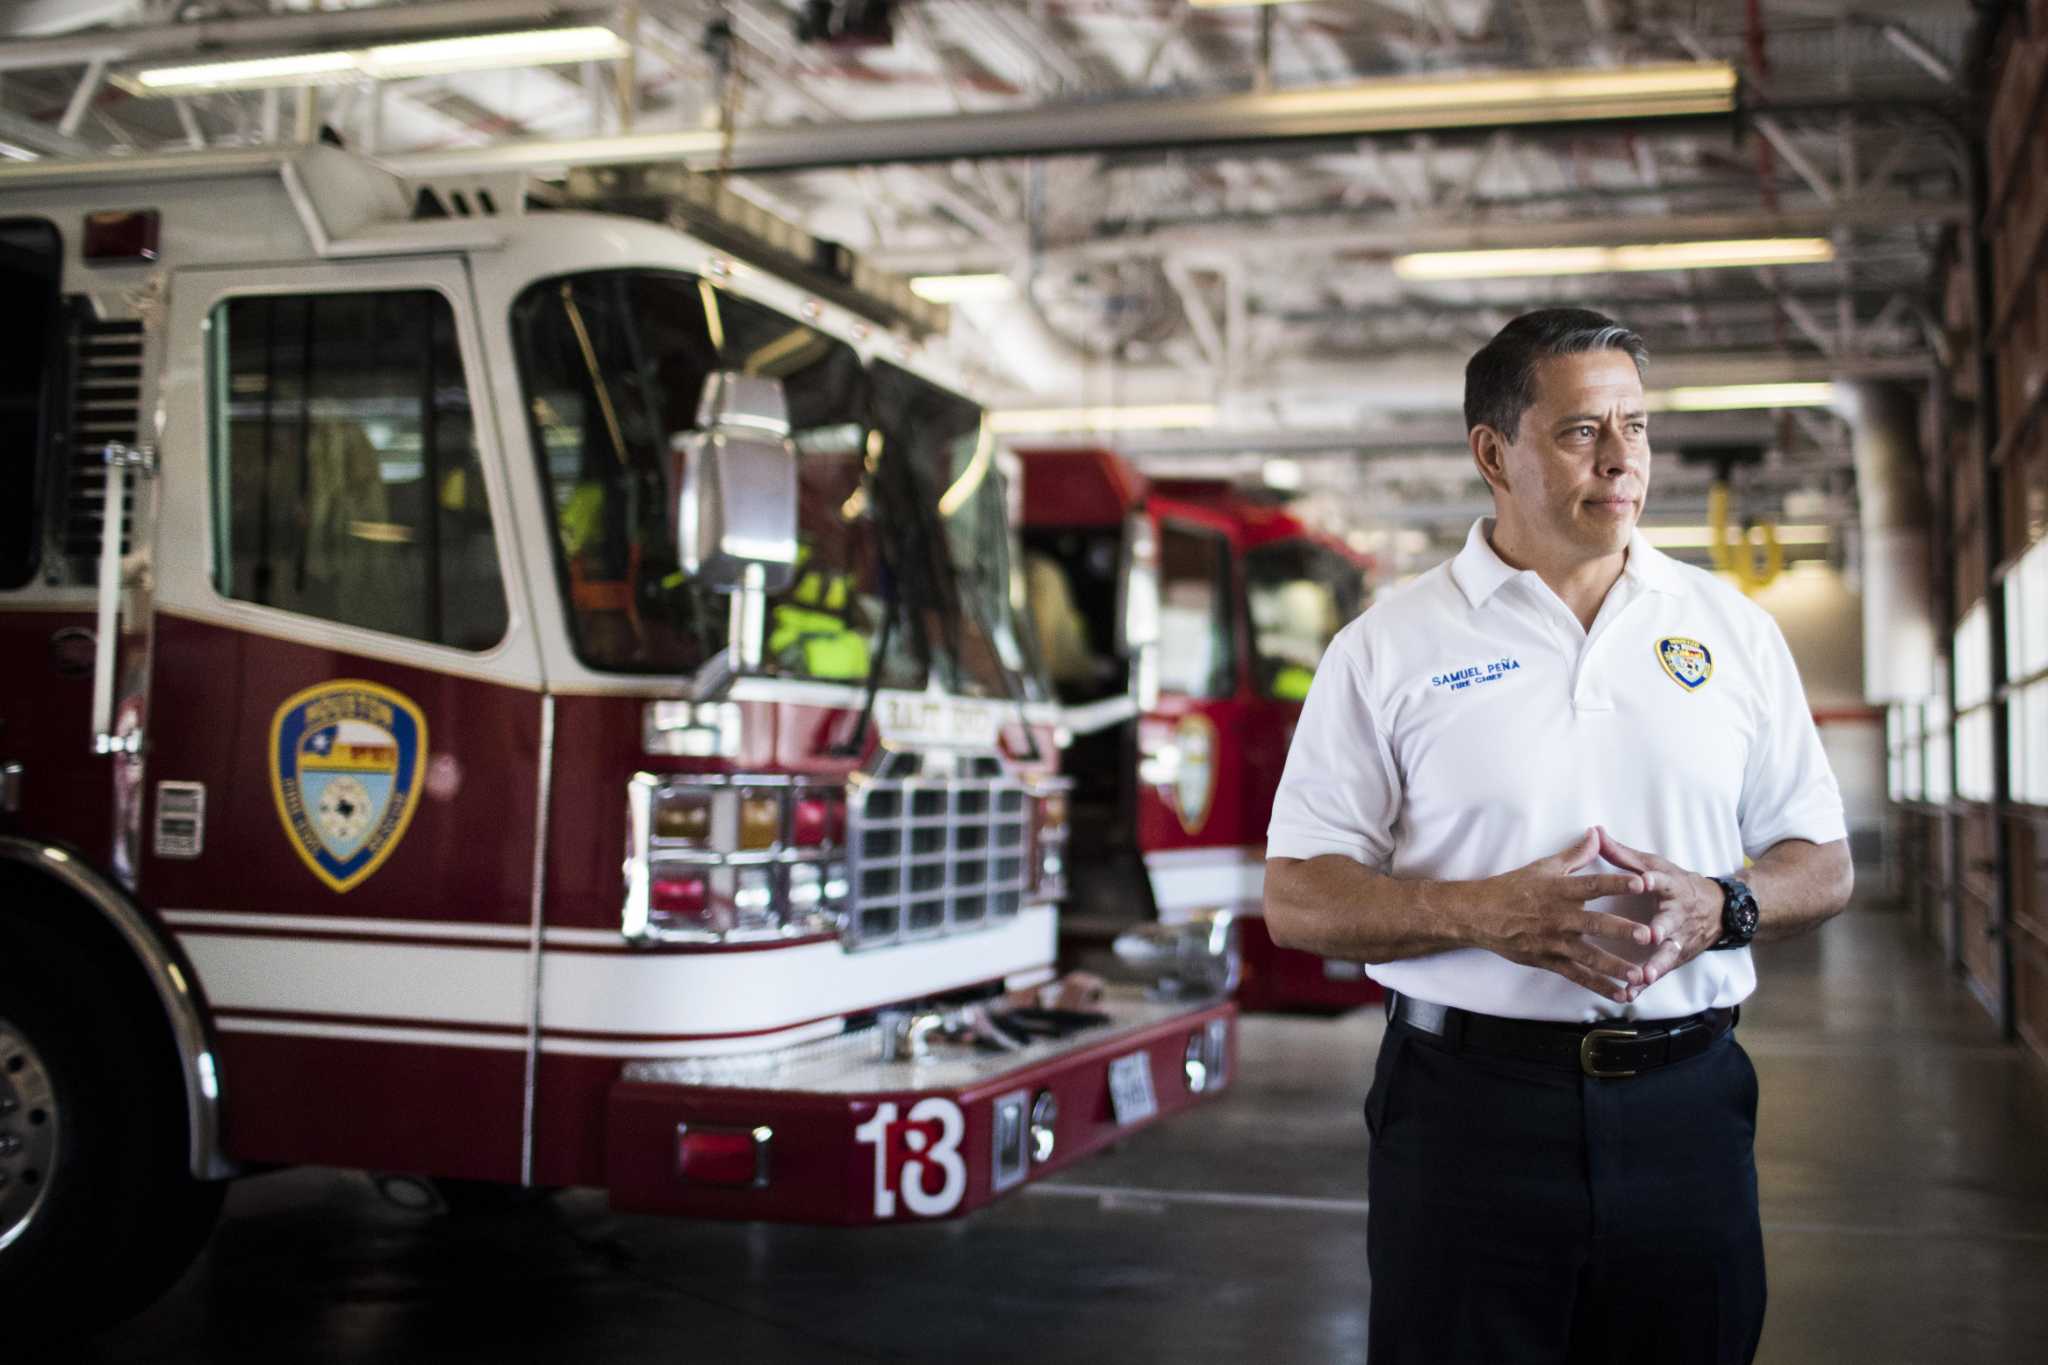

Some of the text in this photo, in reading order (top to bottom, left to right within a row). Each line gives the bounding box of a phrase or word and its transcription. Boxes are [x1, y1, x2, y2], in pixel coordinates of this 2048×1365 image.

[1432, 657, 1520, 687] SAMUEL PEÑA
[1450, 672, 1503, 691] FIRE CHIEF
[855, 1097, 967, 1218] 13
